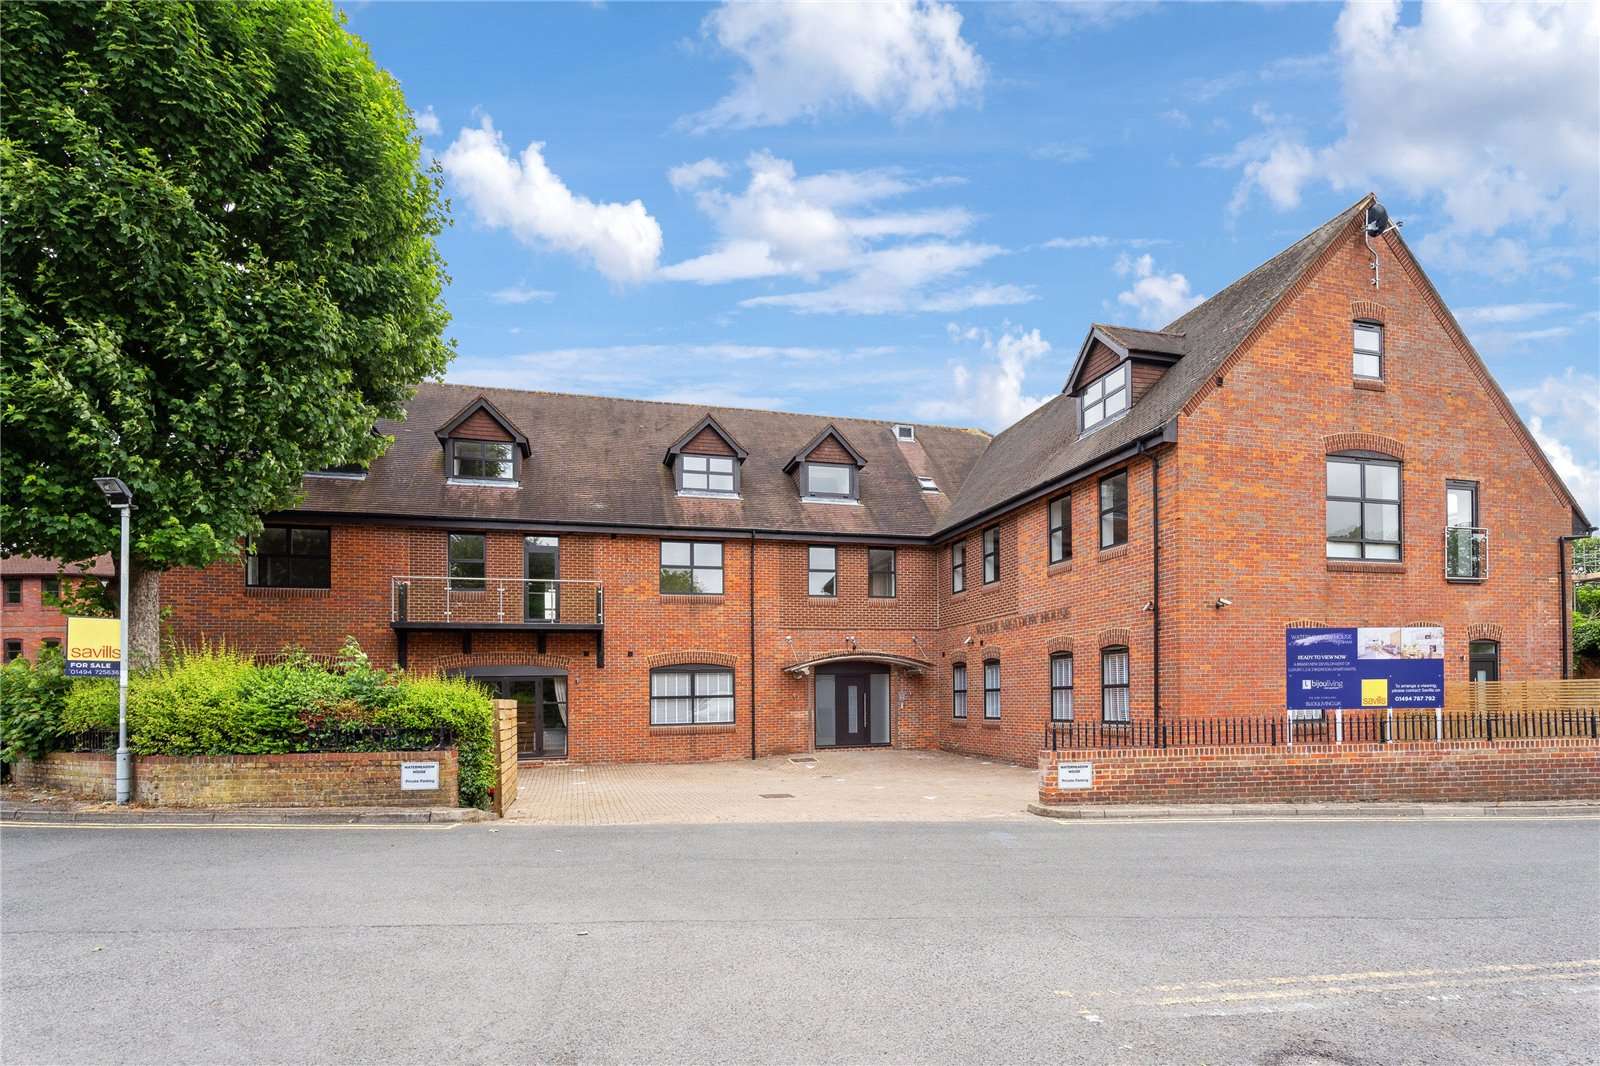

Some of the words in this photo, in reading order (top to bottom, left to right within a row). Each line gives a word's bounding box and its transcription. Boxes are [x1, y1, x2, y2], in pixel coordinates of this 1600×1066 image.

[71, 646, 121, 658] savills
[1312, 680, 1343, 688] bijouliving
[1363, 696, 1386, 704] savills
